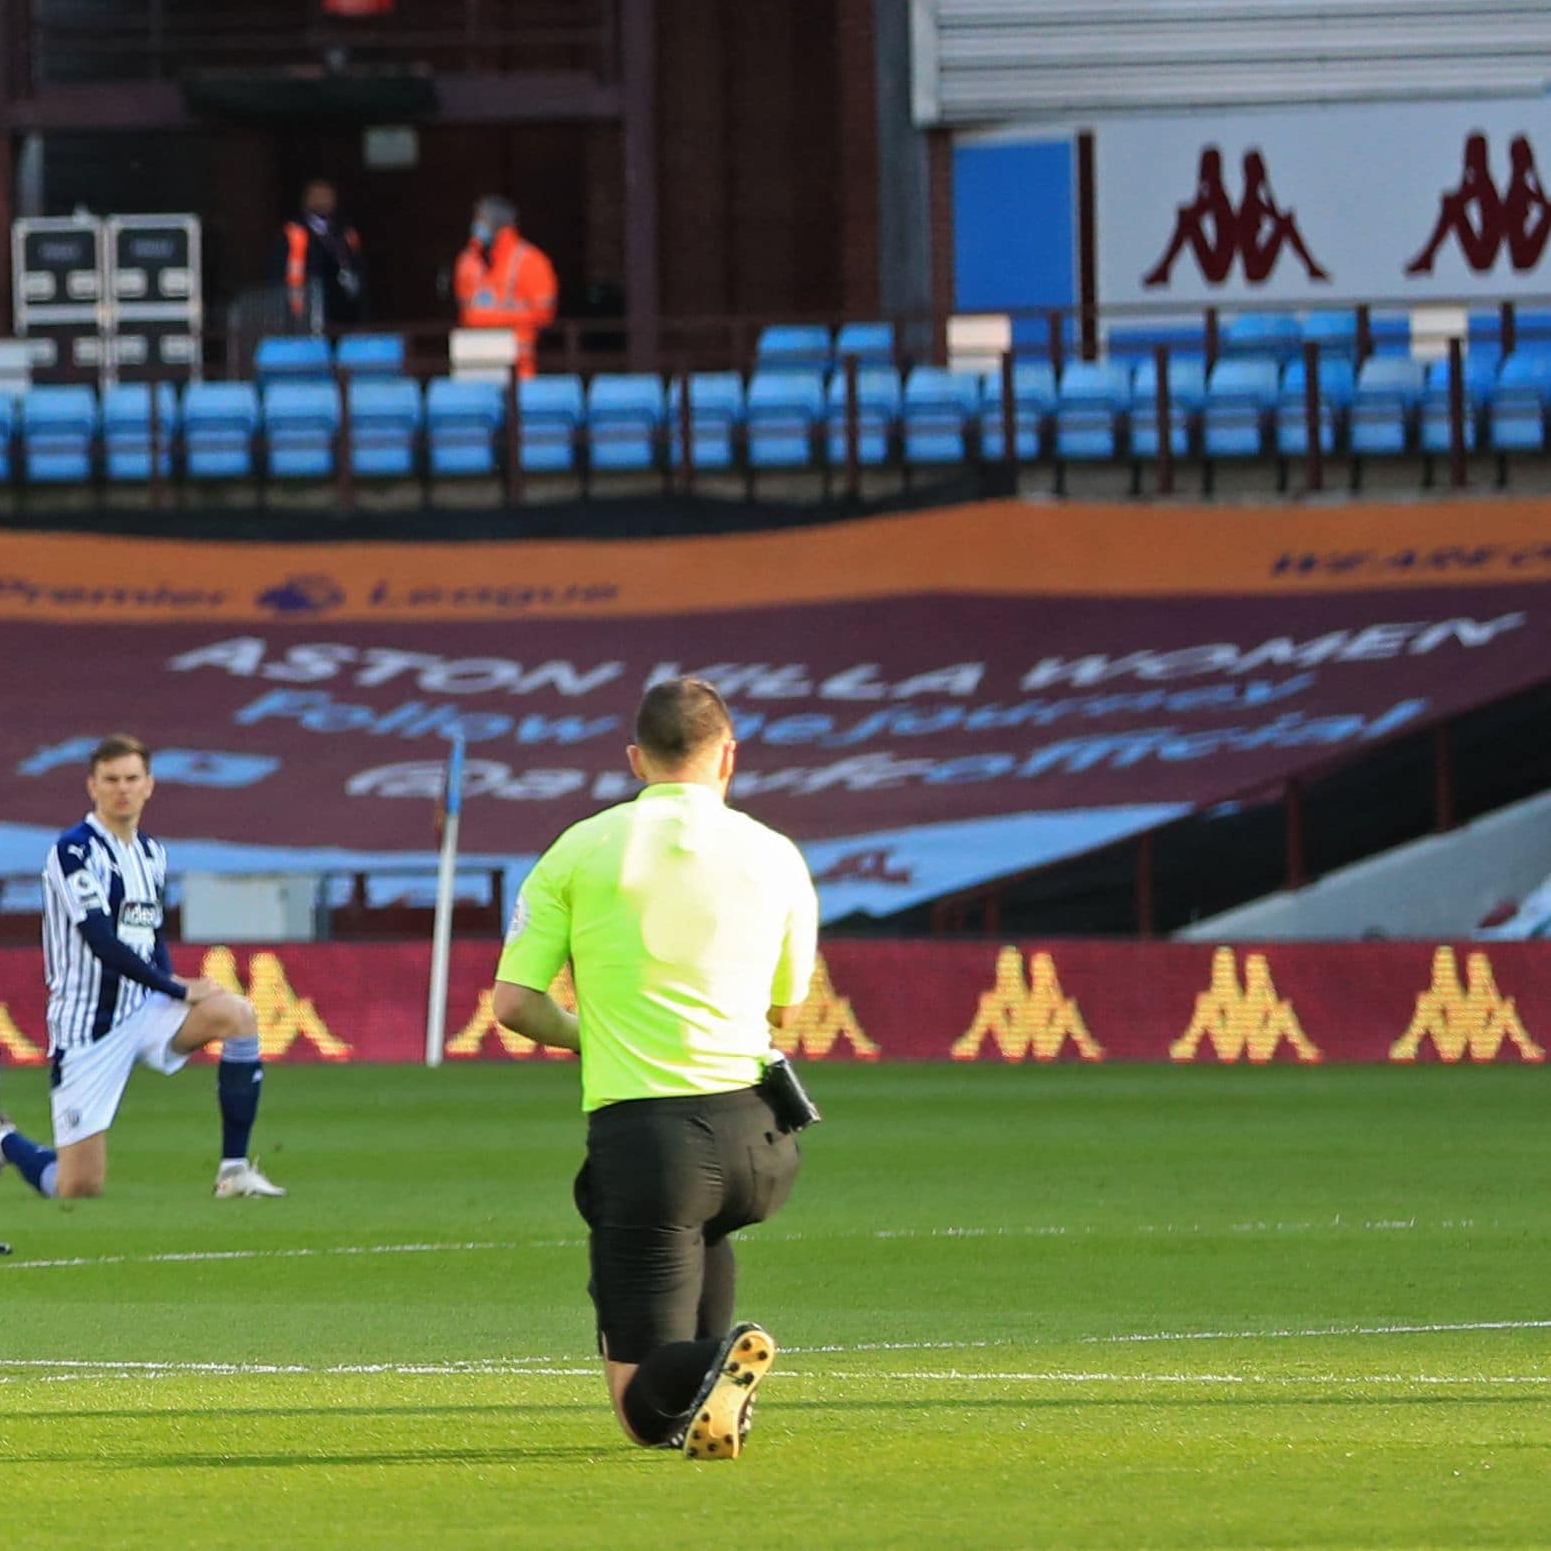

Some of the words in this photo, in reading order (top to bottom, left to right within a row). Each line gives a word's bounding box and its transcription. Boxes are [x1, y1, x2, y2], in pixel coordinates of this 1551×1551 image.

[166, 634, 628, 699] ASTON
[1019, 610, 1528, 692] WOMEN
[232, 685, 621, 747] Follow
